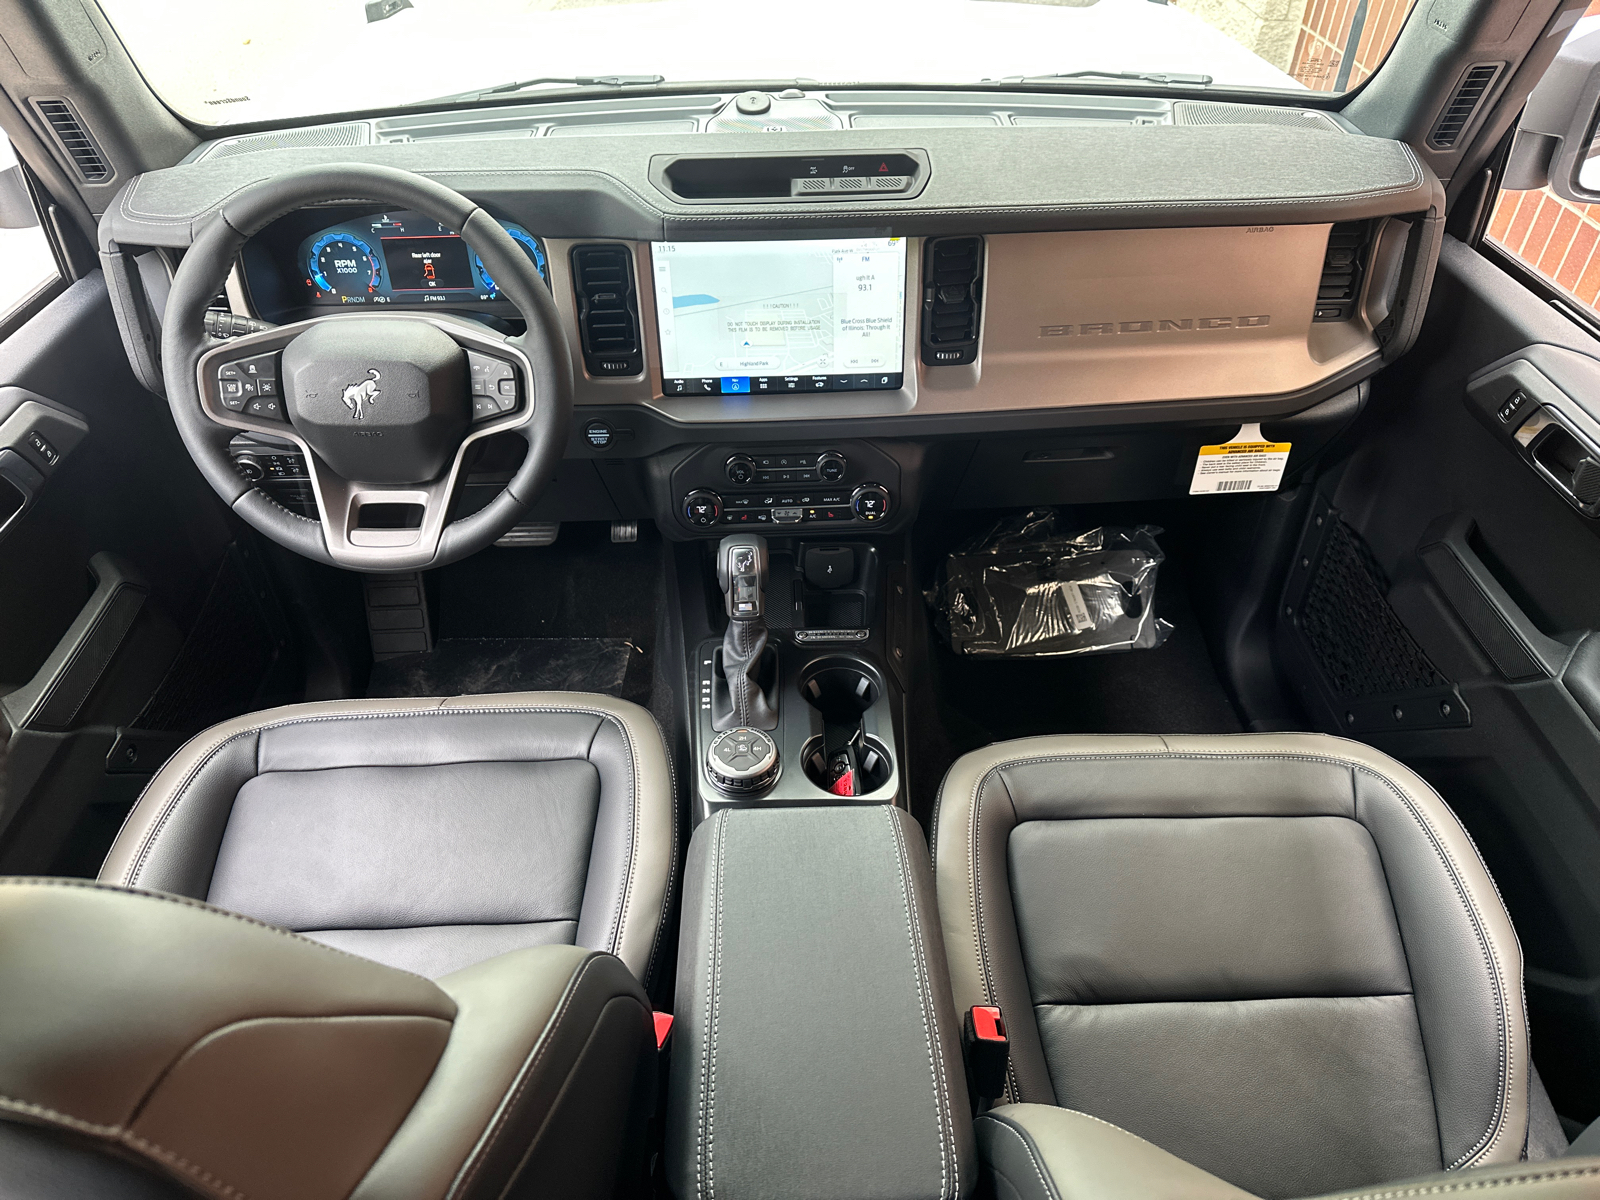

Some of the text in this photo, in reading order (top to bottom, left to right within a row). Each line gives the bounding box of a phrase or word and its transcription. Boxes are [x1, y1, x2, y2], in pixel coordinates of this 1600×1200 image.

[1246, 226, 1274, 234] AIRBAG
[334, 260, 357, 268] RPM
[1037, 314, 1271, 339] BRONCO
